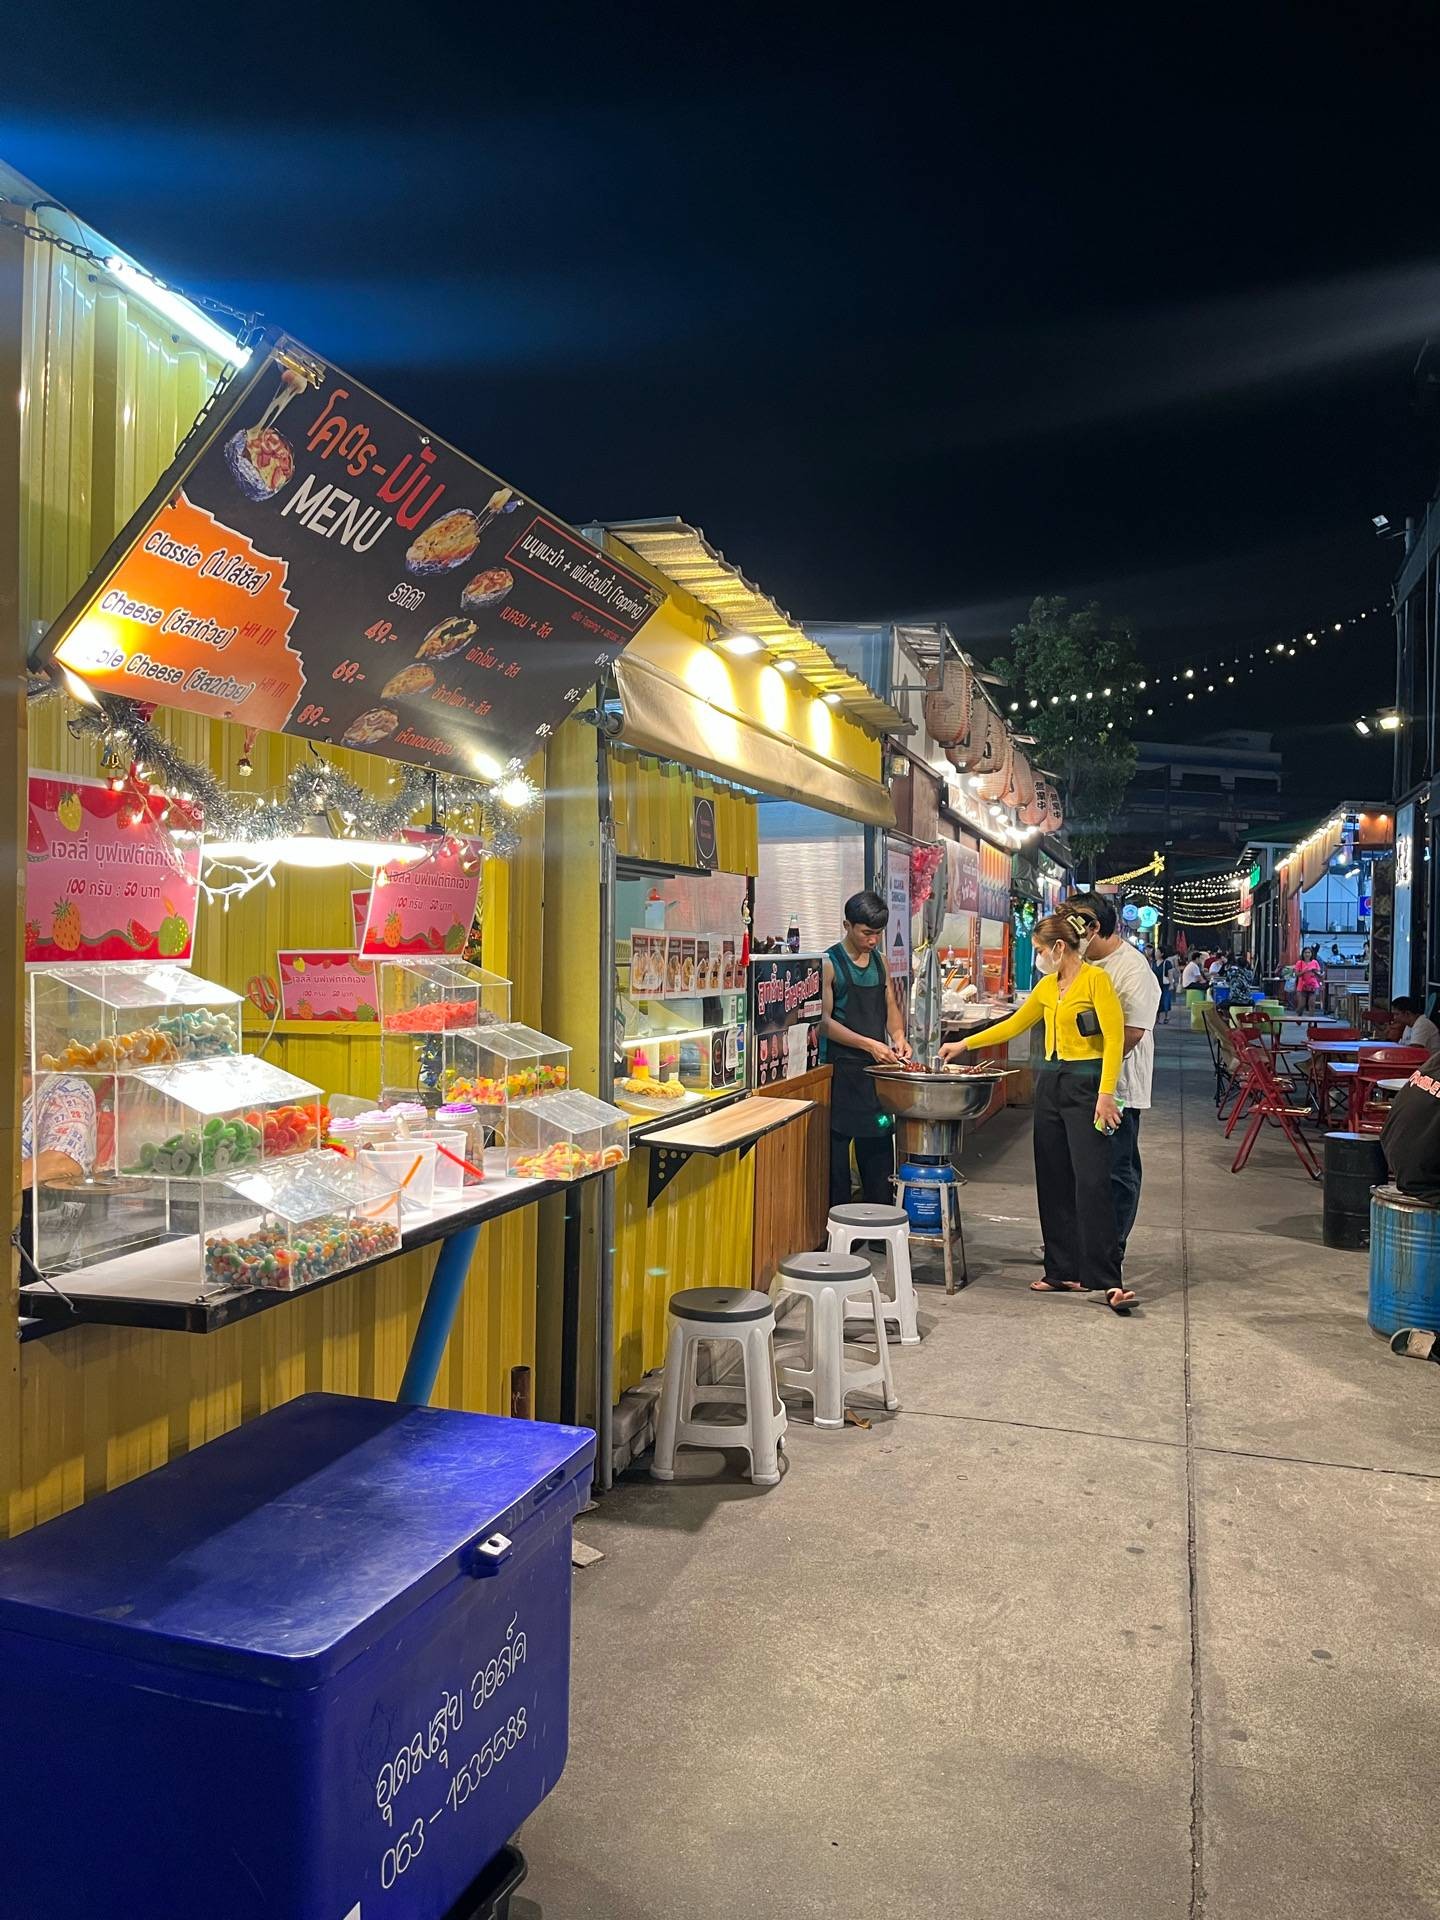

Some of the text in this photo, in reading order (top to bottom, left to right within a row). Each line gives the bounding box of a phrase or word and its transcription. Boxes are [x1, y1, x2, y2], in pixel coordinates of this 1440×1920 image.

[306, 388, 446, 531] โคตร-มัน
[280, 473, 393, 553] MENU
[144, 531, 271, 596] Classic (ไม่ใส่ชีส)
[563, 561, 571, 572] +
[606, 584, 649, 620] (Topping)
[101, 591, 163, 625] Cheese
[387, 582, 426, 611] ราคา
[126, 654, 184, 684] Cheese
[51, 832, 88, 860] เจลลี่
[66, 878, 86, 895] 100
[89, 880, 112, 897] กรัม
[124, 882, 138, 897] 50
[141, 885, 160, 899] บาท
[376, 1689, 463, 1827] อุดมสุข
[382, 1818, 424, 1889] 063
[446, 1707, 527, 1811] 1535588
